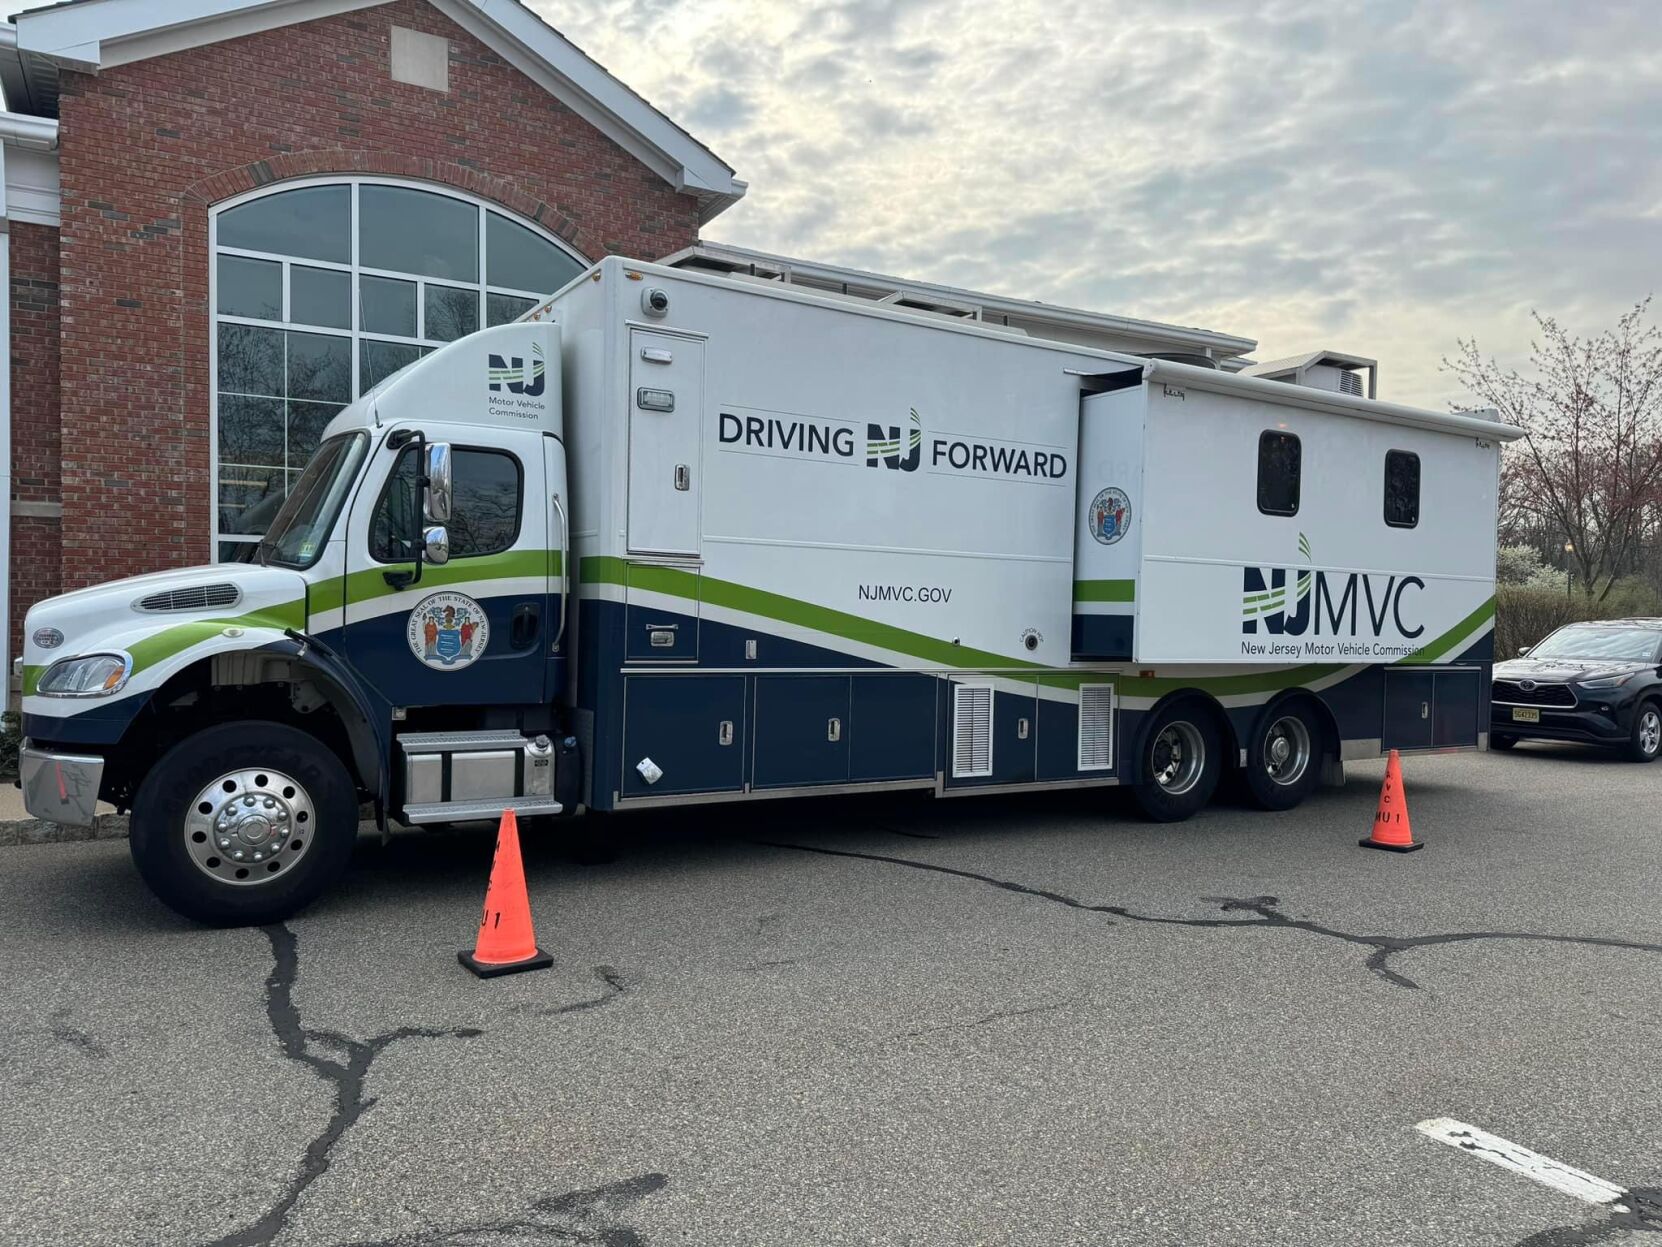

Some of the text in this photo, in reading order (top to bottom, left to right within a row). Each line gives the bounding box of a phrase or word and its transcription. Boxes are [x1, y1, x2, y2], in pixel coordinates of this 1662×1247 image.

[489, 354, 545, 396] NJ
[489, 396, 545, 410] Motor Vehicle
[489, 407, 539, 420] Commission
[719, 413, 1067, 479] DRIVING NJ FORWARD
[859, 585, 952, 603] NJMVC.GOV
[410, 619, 418, 640] GREAT
[416, 604, 428, 617] SEAL
[428, 598, 436, 606] OF
[454, 596, 473, 609] STATE
[1241, 641, 1425, 658] New Jersey Motor Vehicle Commission
